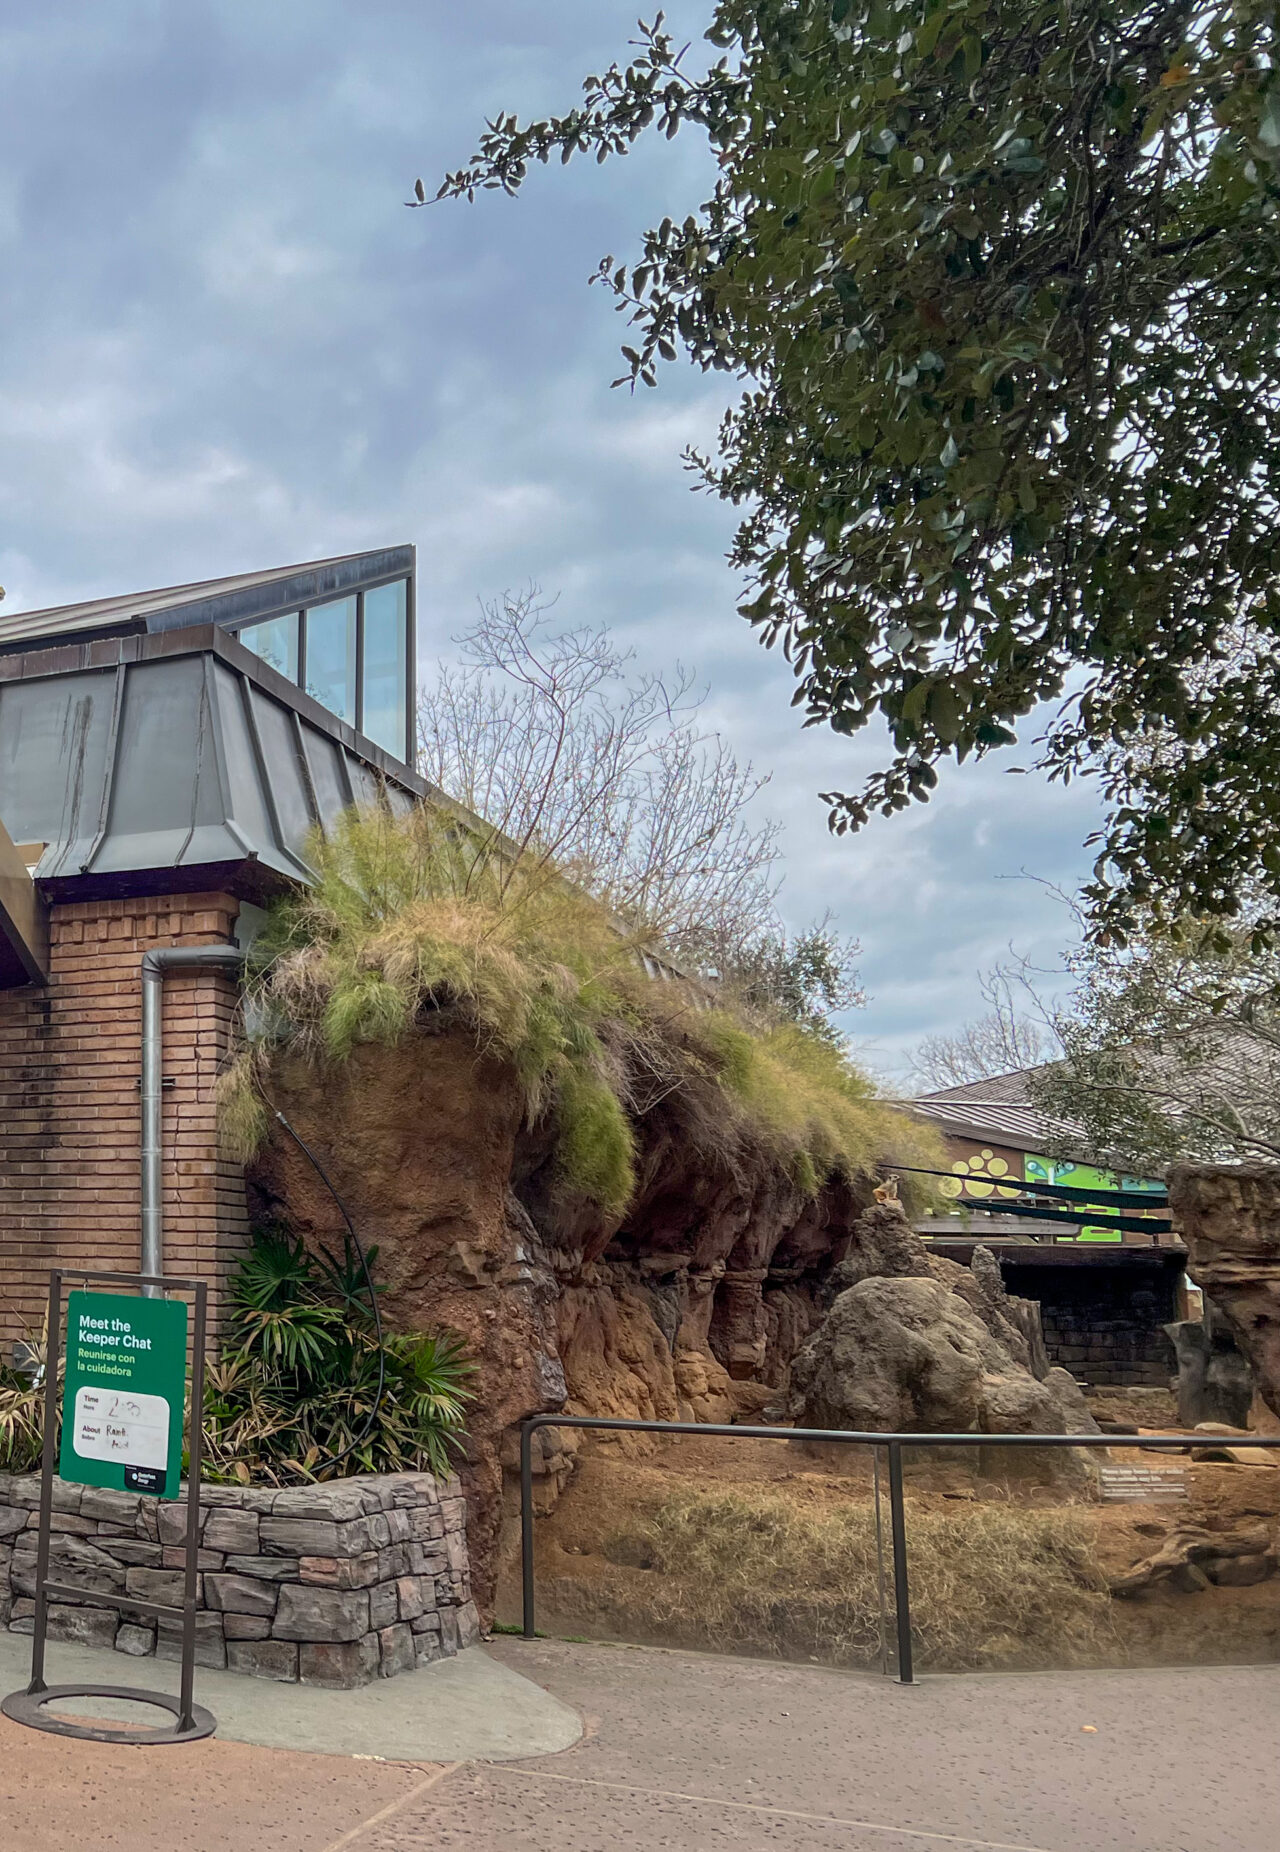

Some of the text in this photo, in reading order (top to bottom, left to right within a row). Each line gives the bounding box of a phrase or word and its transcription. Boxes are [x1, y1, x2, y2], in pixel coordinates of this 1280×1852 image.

[80, 1315, 131, 1332] Meet the
[79, 1330, 152, 1350] Keeper Chat
[78, 1347, 136, 1364] Reunirse con
[77, 1360, 132, 1377] la cuidadora
[84, 1395, 99, 1403] Time
[82, 1425, 101, 1434] About
